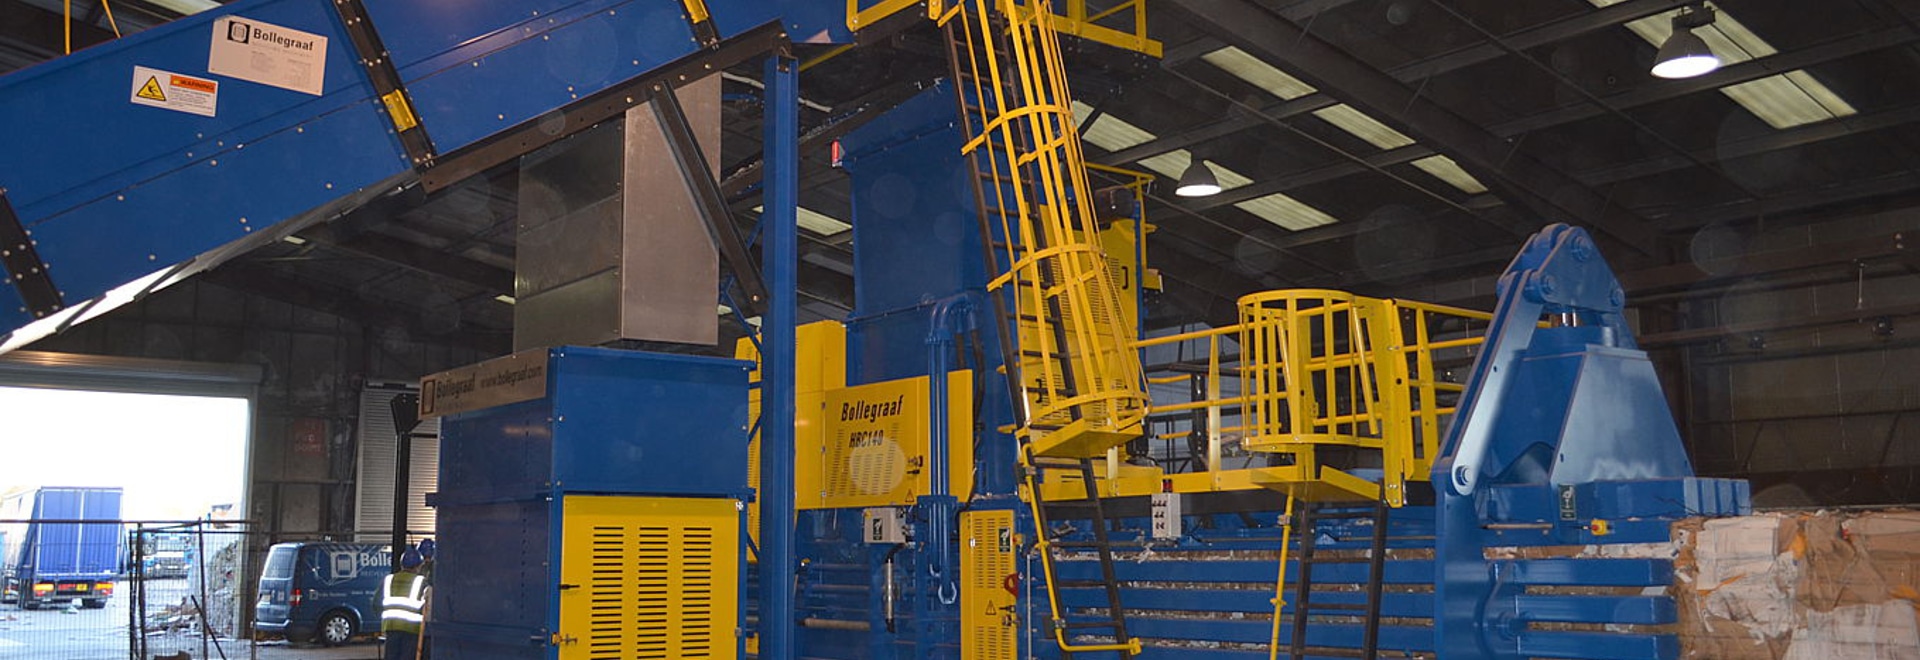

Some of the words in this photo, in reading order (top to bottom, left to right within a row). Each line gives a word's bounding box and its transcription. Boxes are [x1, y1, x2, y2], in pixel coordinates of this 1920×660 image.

[253, 28, 313, 51] Bollegraaf
[436, 373, 476, 399] Bollegraaf
[841, 394, 904, 423] Bollegraaf
[849, 429, 884, 448] HBC140
